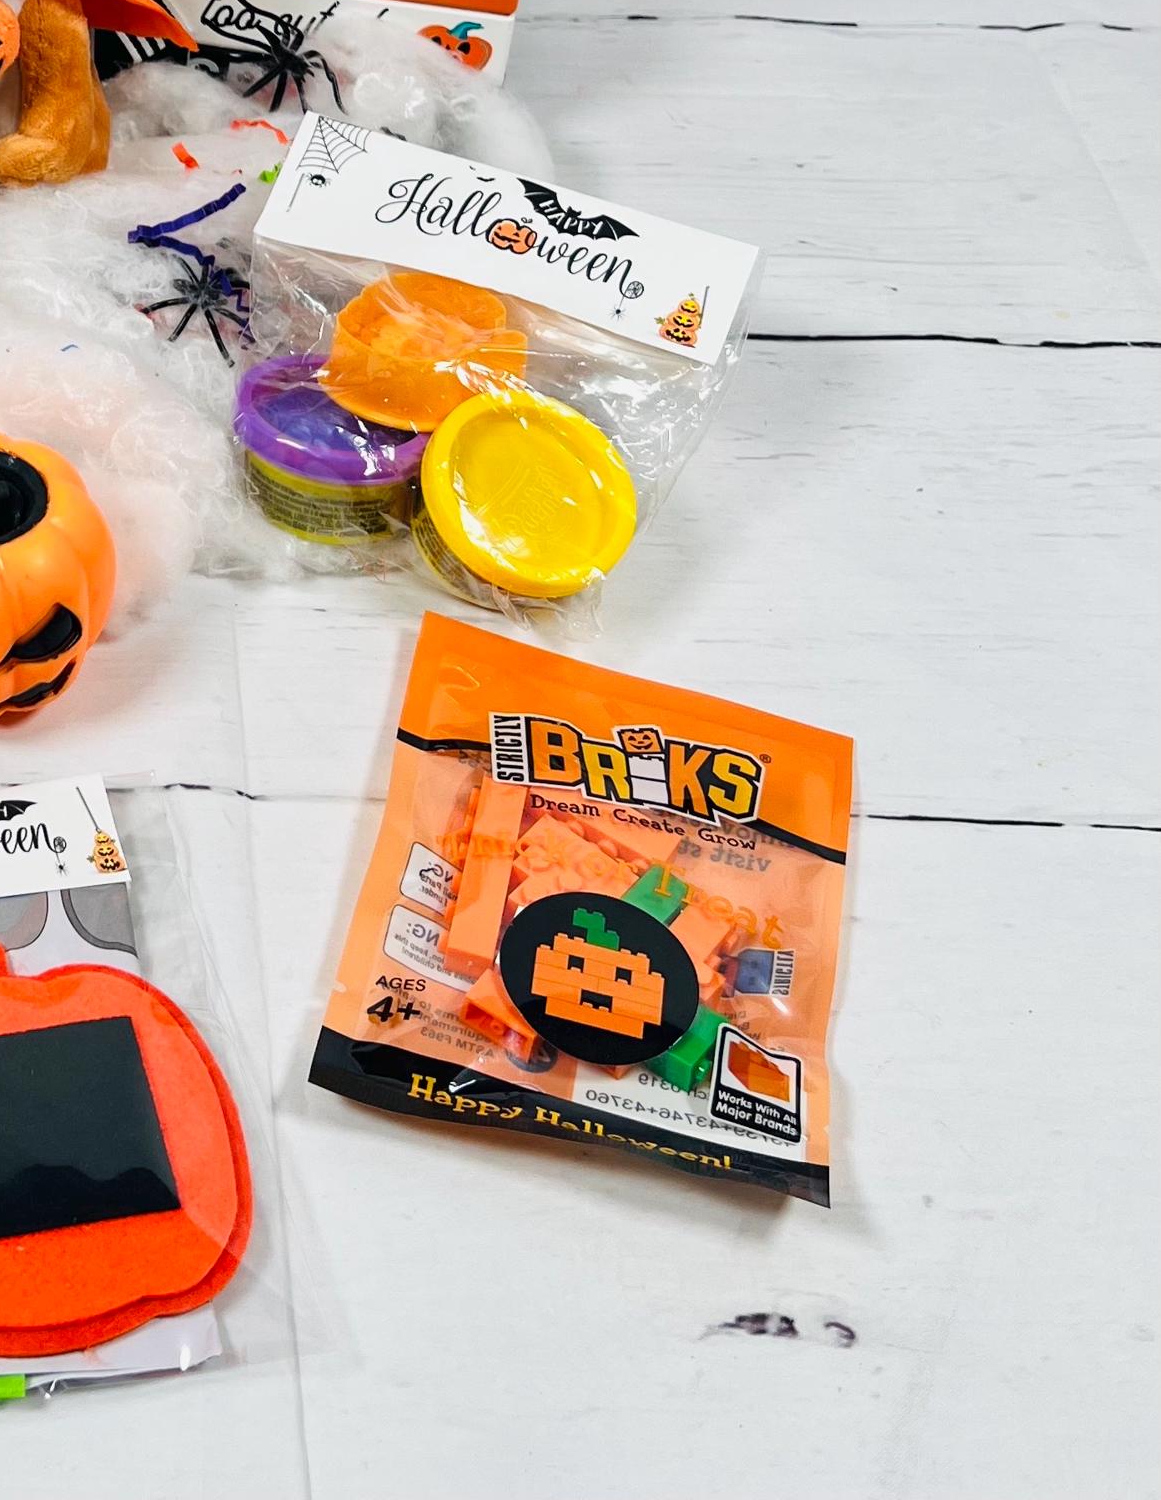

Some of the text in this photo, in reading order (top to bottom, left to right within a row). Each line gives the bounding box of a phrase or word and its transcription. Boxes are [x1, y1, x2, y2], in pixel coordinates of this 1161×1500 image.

[375, 173, 644, 299] Halloween
[540, 199, 604, 236] HAPPY
[494, 714, 525, 782] STRICTLY
[530, 794, 601, 818] Dream
[613, 808, 686, 837] Create
[698, 827, 757, 851] Grow
[376, 975, 427, 992] AGES
[367, 996, 421, 1022] 4+
[407, 1073, 733, 1170] Happy Halloween!
[715, 1101, 798, 1136] Major Brands
[717, 1090, 755, 1109] Works
[755, 1102, 781, 1119] With
[782, 1112, 797, 1125] All
